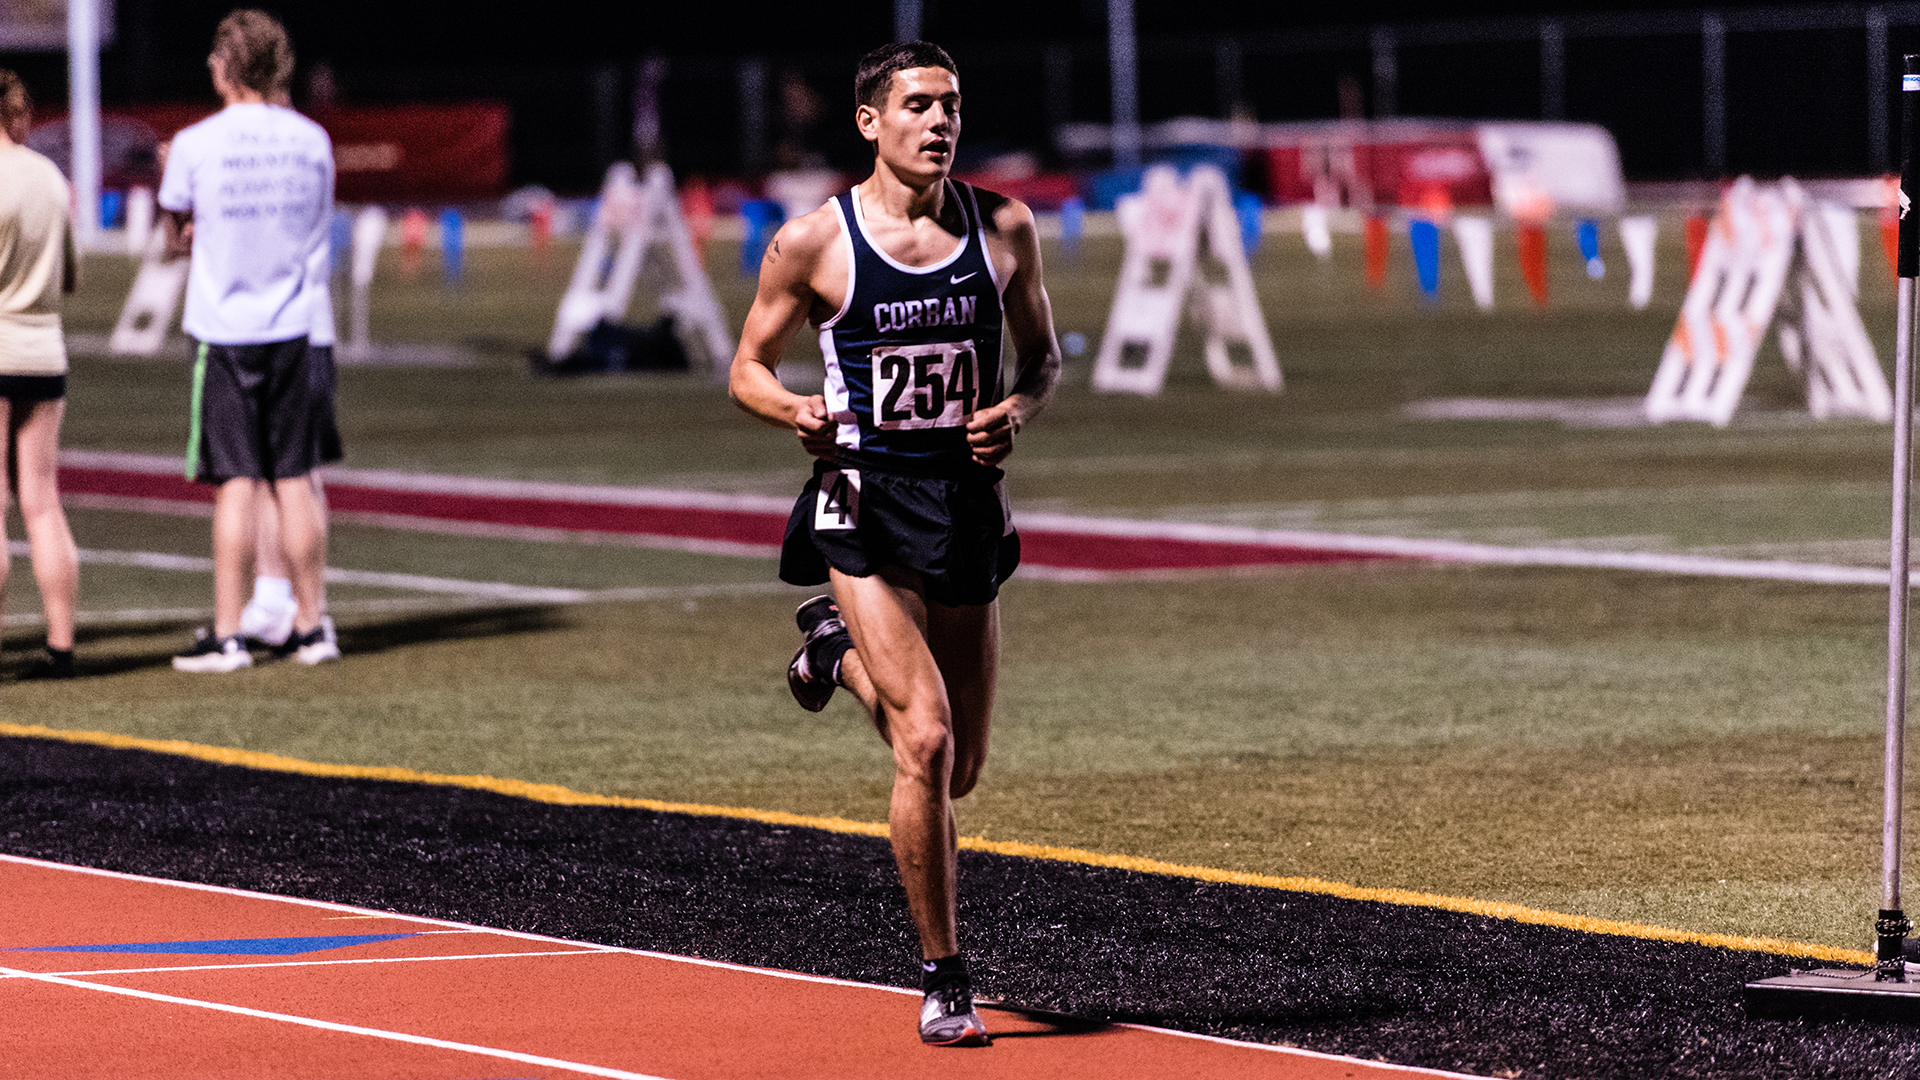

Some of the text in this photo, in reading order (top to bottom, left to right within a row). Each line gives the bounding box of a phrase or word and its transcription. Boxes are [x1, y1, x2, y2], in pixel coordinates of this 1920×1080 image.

[874, 295, 977, 332] CORBAN
[880, 352, 976, 421] 254
[823, 472, 851, 525] 4
